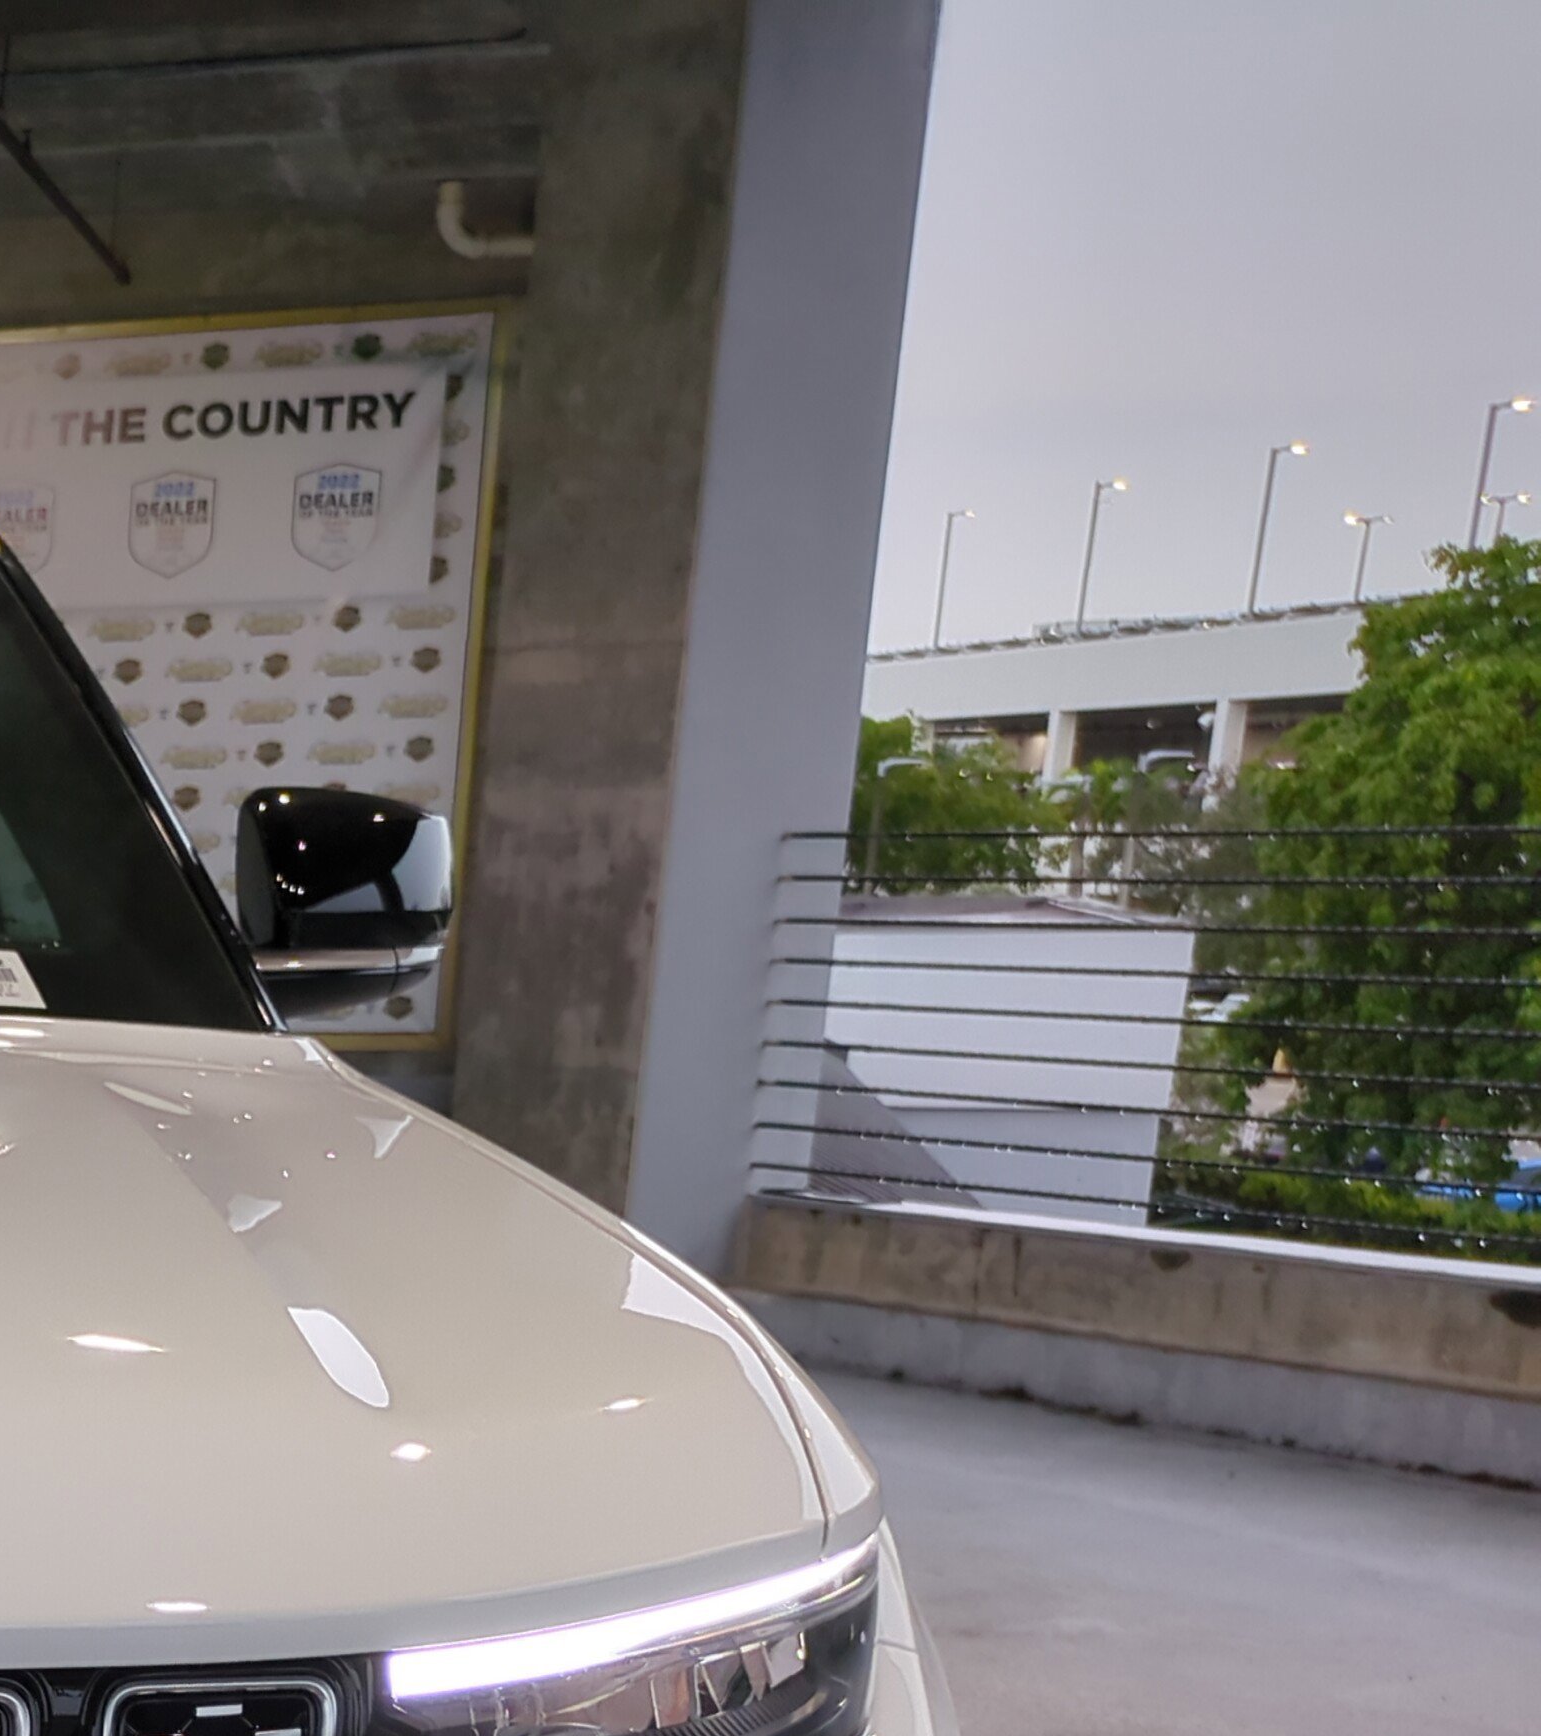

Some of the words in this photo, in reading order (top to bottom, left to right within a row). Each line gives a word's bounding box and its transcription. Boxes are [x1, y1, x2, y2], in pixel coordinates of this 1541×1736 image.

[50, 407, 148, 447] THE
[161, 391, 416, 442] COUNTRY
[136, 499, 209, 518] DEALER
[299, 491, 373, 510] DEALER
